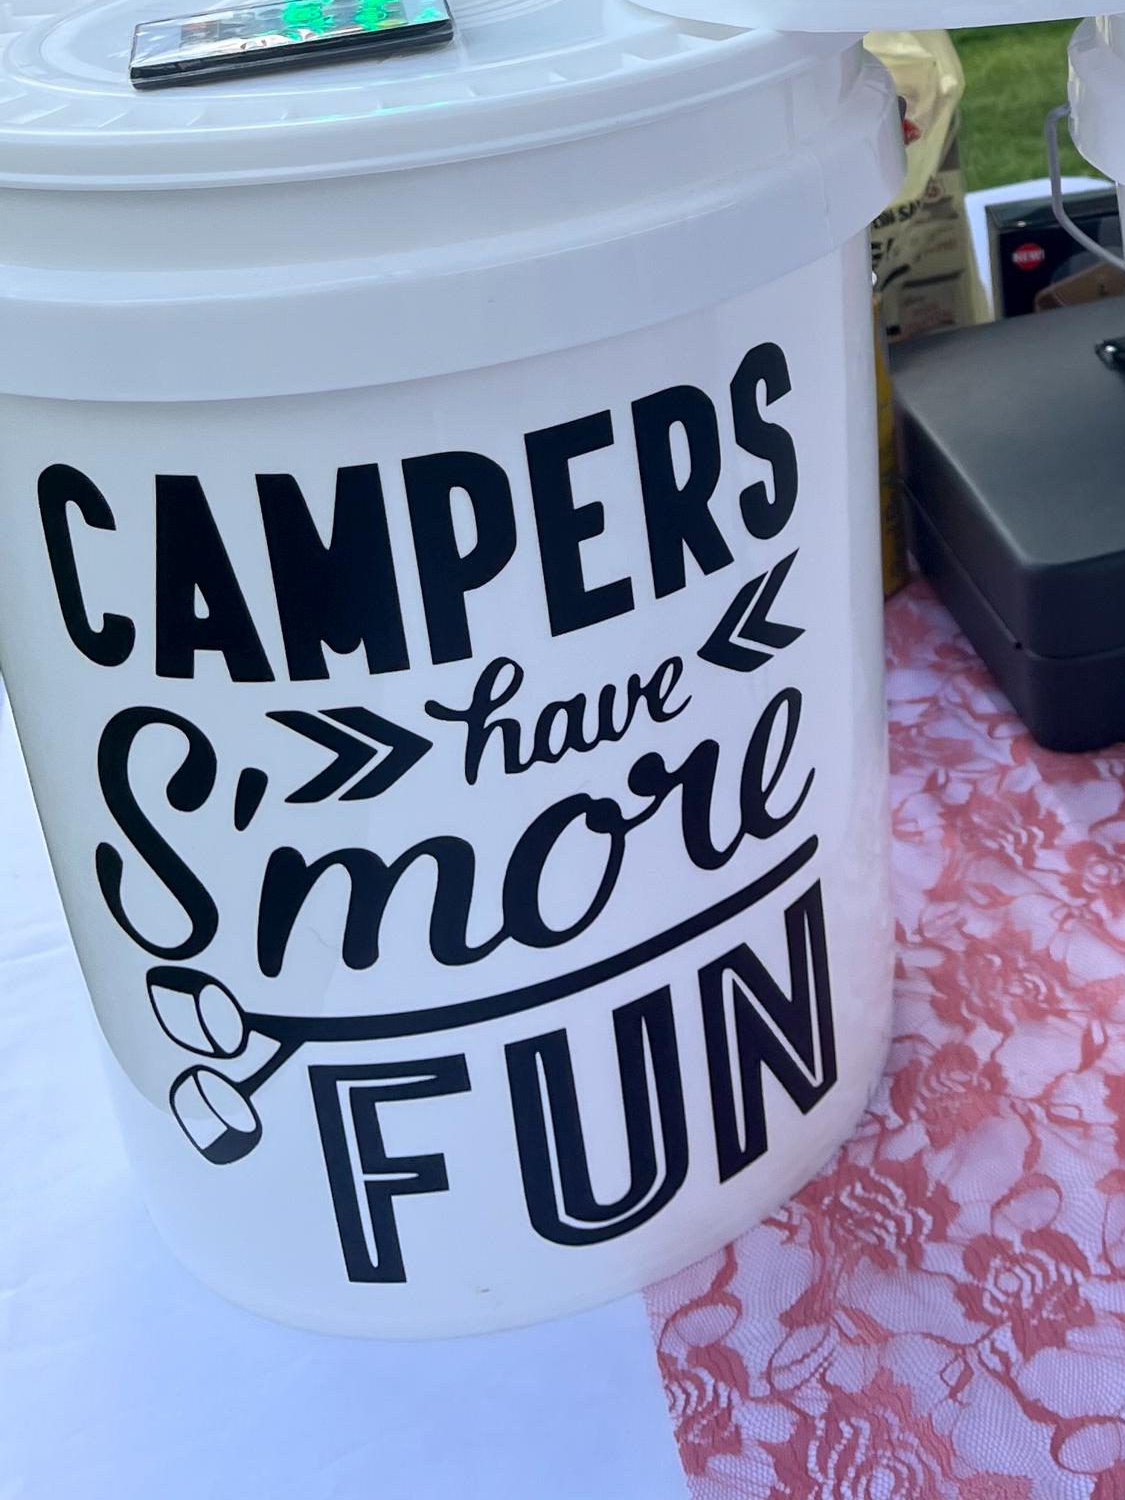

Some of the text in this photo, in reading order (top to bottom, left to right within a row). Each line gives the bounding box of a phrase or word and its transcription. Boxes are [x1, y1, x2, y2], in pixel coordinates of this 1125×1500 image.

[37, 341, 800, 682] CAMPERS
[425, 656, 693, 785] have
[308, 876, 839, 1284] FUN
